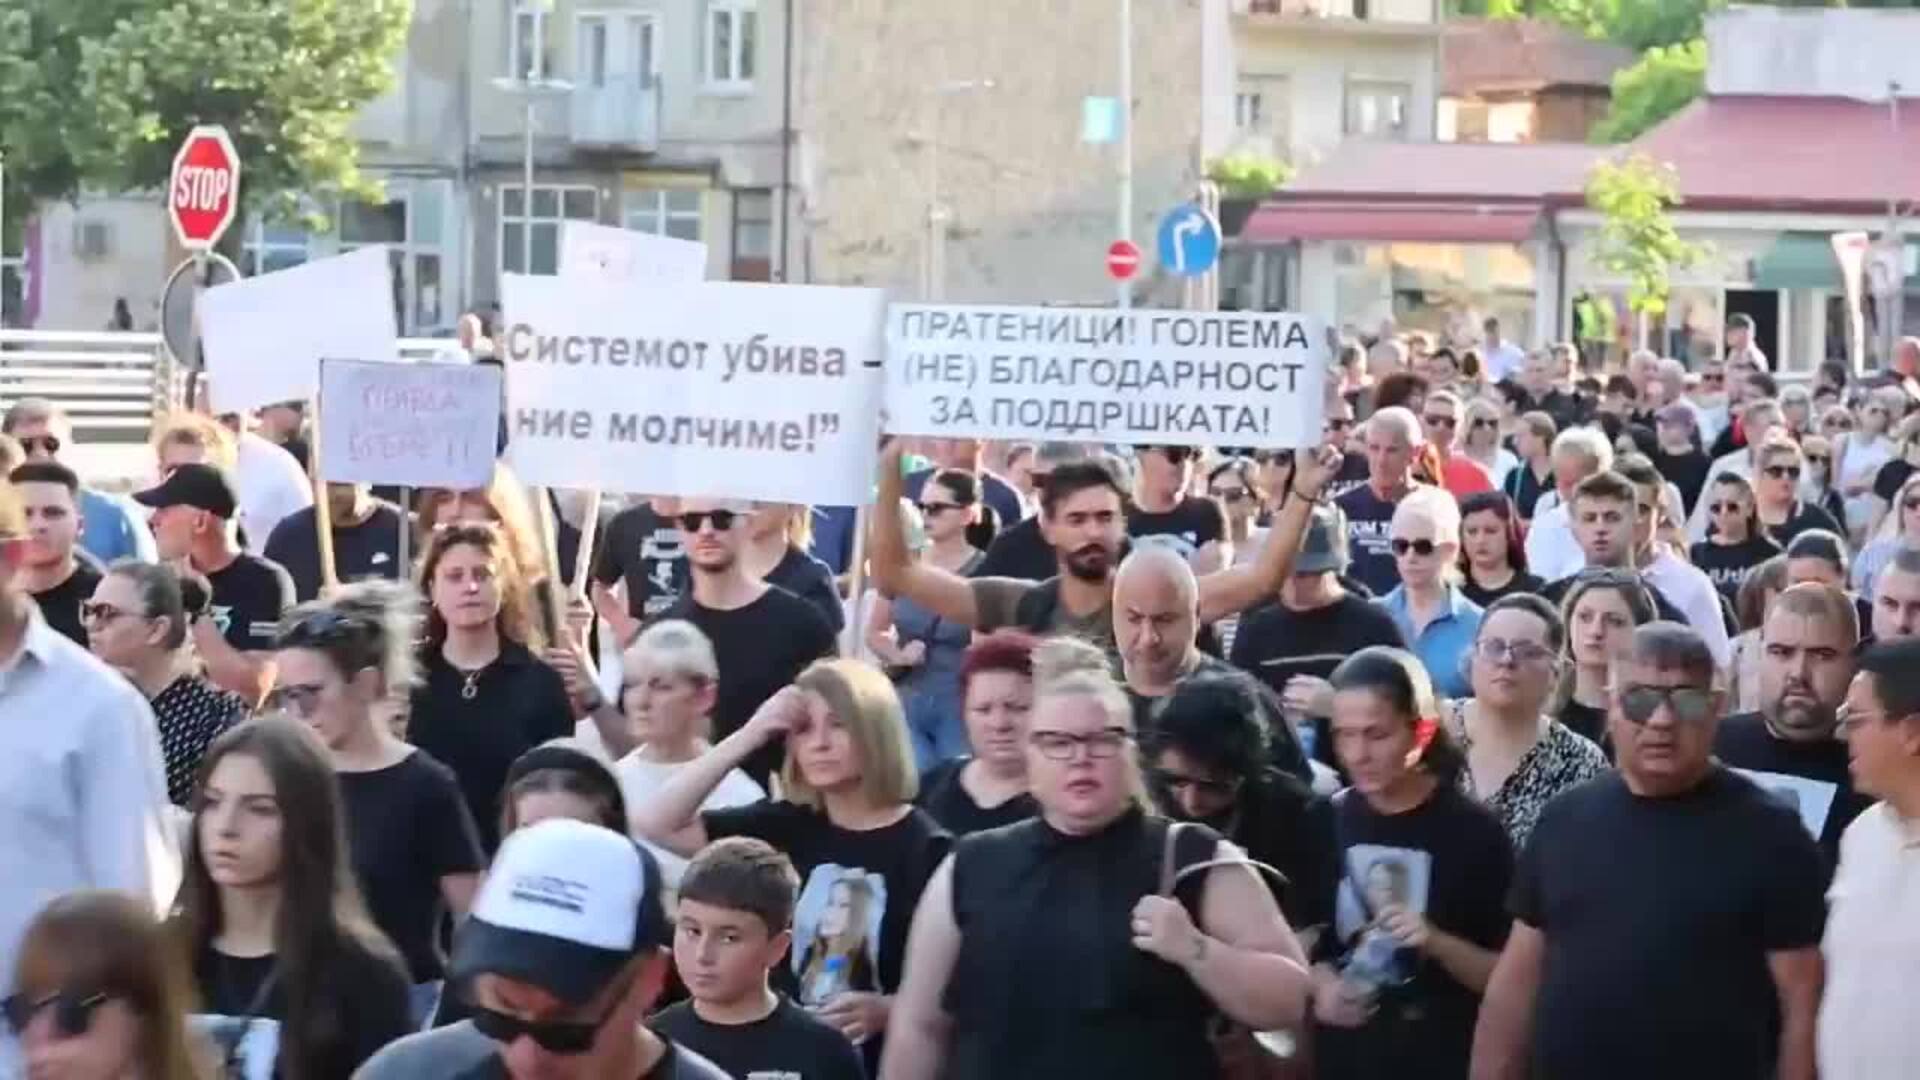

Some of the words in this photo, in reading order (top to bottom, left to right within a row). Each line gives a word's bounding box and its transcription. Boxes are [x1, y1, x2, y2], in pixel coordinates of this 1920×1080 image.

[178, 165, 229, 212] STOP
[902, 311, 1137, 348] ПРАТЕНИЦИ!
[1152, 317, 1310, 350] ГОЛЕМА
[508, 322, 710, 370] Системот
[722, 333, 846, 383] убива
[904, 354, 978, 389] (НЕ)
[989, 354, 1306, 394] БЛАГОДАРНОСТ
[516, 405, 593, 439] ние
[930, 396, 978, 425] ЗА
[991, 398, 1270, 434] ПОДДРШКАТА!
